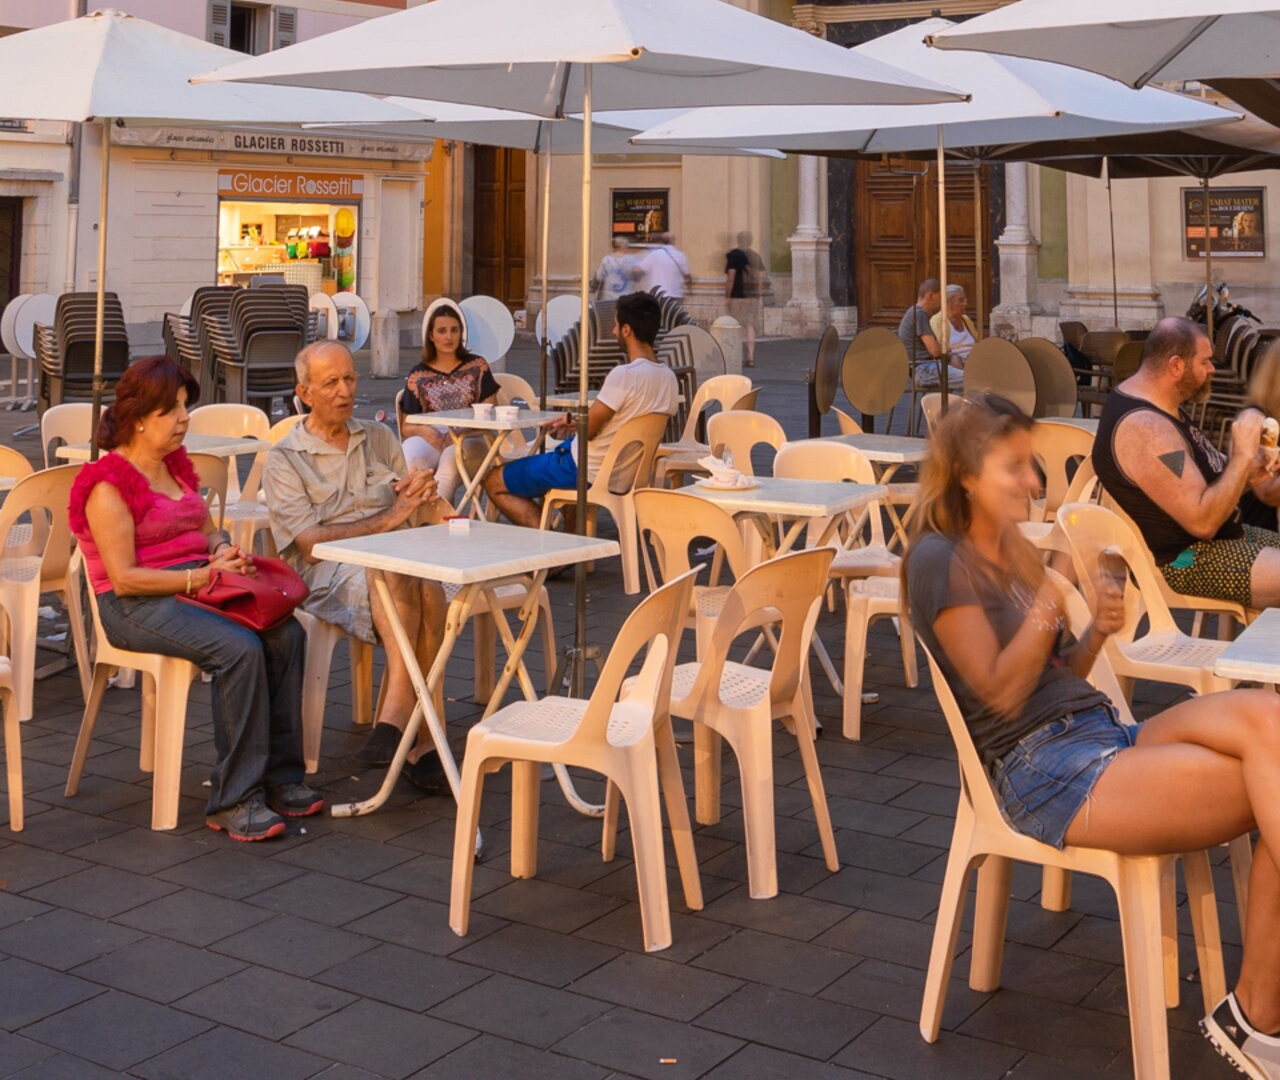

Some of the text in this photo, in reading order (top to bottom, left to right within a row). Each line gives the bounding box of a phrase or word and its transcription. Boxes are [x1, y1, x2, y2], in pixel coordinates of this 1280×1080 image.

[233, 135, 345, 154] GLACIER ROSSETTI
[233, 173, 352, 195] Glacier Rossetti
